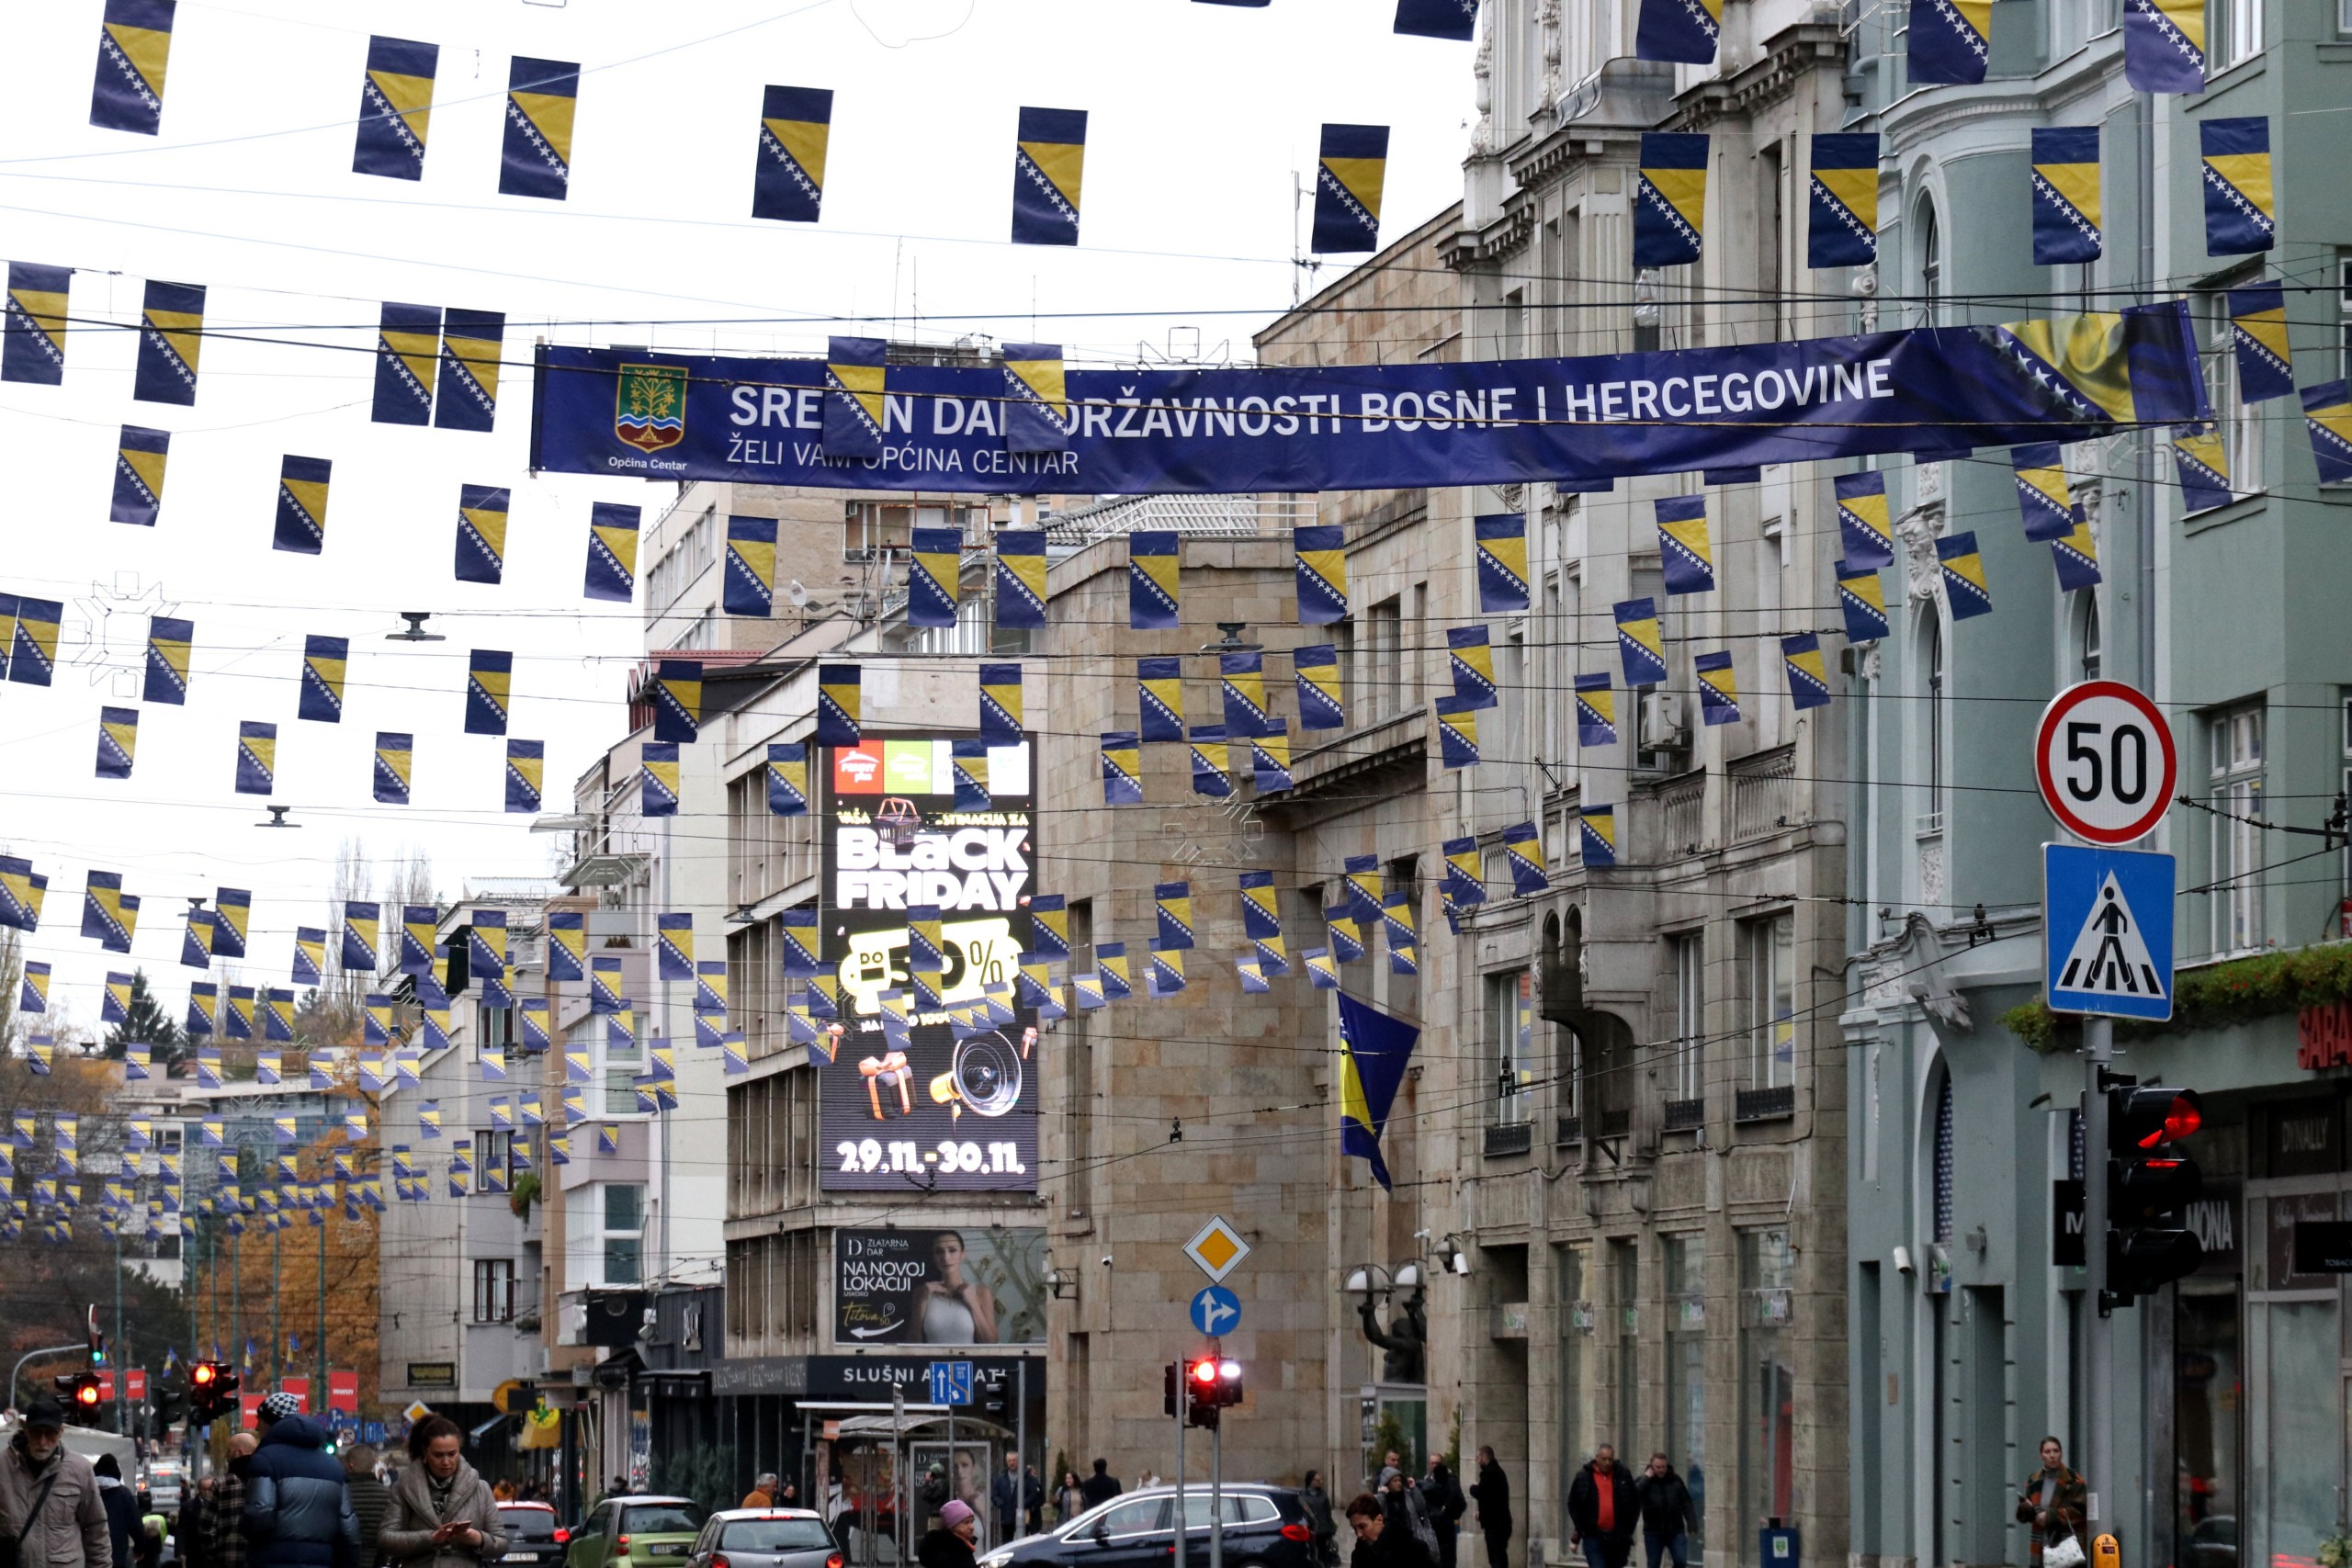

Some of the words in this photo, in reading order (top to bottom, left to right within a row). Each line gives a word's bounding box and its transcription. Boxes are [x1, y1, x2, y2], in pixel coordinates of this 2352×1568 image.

[730, 386, 912, 433] SREN
[934, 397, 1006, 435] DA
[1361, 389, 1519, 432] BOSNE
[1537, 386, 1546, 425] I
[1566, 358, 1894, 423] HERCEGOVINE
[727, 432, 783, 465] ŽELI
[973, 448, 1079, 475] CENTAR
[608, 457, 648, 469] Općina
[650, 459, 688, 471] Centar
[2067, 722, 2146, 805] 50
[837, 871, 1029, 908] FRIDAY
[860, 952, 884, 965] DO
[867, 1238, 910, 1247] ZLATARNA
[867, 1248, 884, 1257] DAR
[843, 1262, 867, 1276] NA
[871, 1262, 925, 1277] NOVOJ
[843, 1276, 911, 1292] LOKACIJI
[842, 1302, 879, 1326] Titova
[843, 1363, 914, 1382] SLUŠNI
